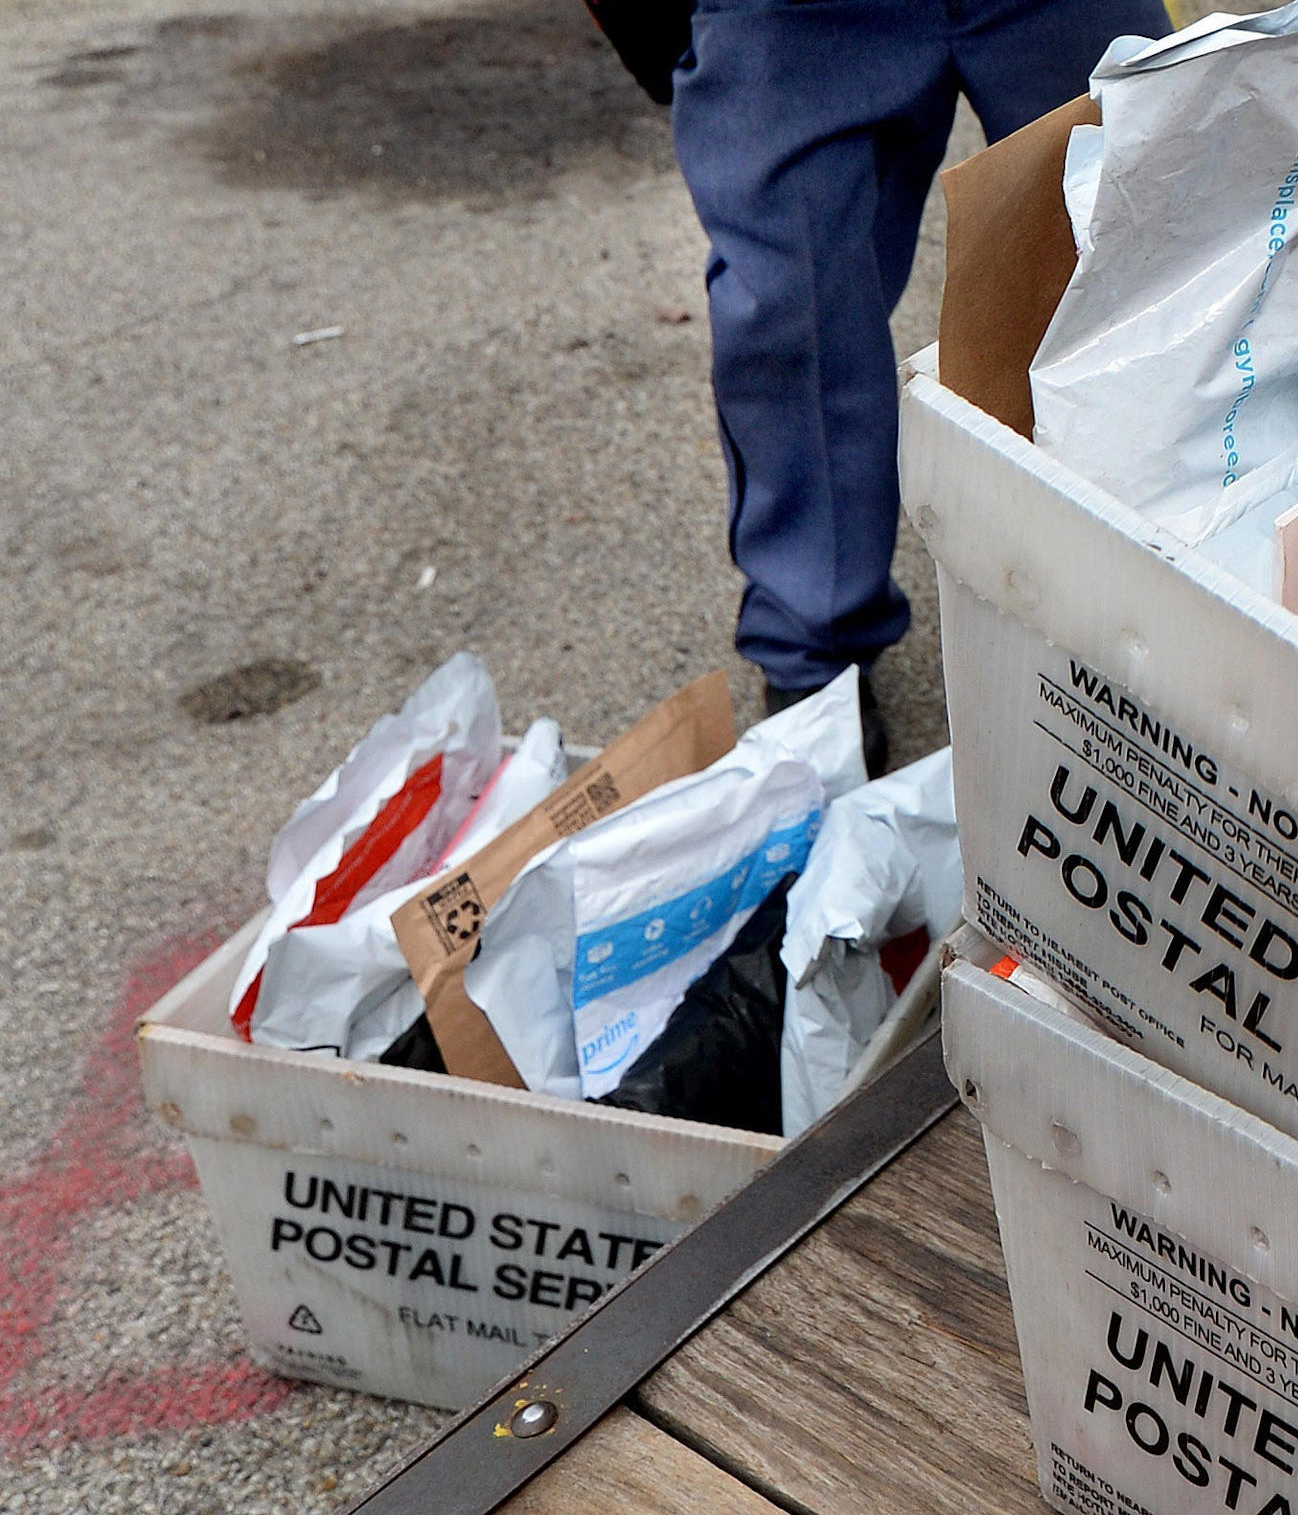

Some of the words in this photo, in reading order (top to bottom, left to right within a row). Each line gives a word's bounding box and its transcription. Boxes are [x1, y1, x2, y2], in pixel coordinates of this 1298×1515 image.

[1039, 681, 1124, 757] MAXIMUM
[1126, 748, 1209, 816] PENALTY
[1210, 807, 1252, 850] FOR
[1069, 659, 1219, 786] WARNING
[1081, 739, 1136, 789] $1,000
[1138, 778, 1180, 824] FINE
[1180, 814, 1221, 853] AND
[1224, 844, 1236, 863] 3
[976, 891, 992, 910] TO
[976, 875, 1021, 923] RETURN
[1023, 917, 1040, 936] TO
[1017, 814, 1283, 1054] POSTAL
[581, 1011, 637, 1067] prime
[1199, 1014, 1255, 1071] FOR
[270, 1217, 479, 1293] POSTAL
[492, 1262, 610, 1313] SER
[284, 1171, 476, 1241] UNITED
[489, 1212, 664, 1271] STATE
[1110, 1202, 1251, 1308] WARNING
[400, 1305, 458, 1334] FLAT
[466, 1320, 527, 1349] MAIL
[1087, 1230, 1166, 1290] MAXIMUM
[1169, 1282, 1247, 1341] PENALTY
[1250, 1331, 1288, 1369] FOR
[1129, 1281, 1180, 1326] $1,000
[1183, 1316, 1222, 1351] FINE
[1224, 1344, 1261, 1375] AND
[1265, 1367, 1276, 1385] 3
[1050, 1441, 1096, 1483] RETURN
[1097, 1476, 1114, 1496] TO
[1051, 1457, 1066, 1477] TO
[1068, 1471, 1115, 1511] REPORT
